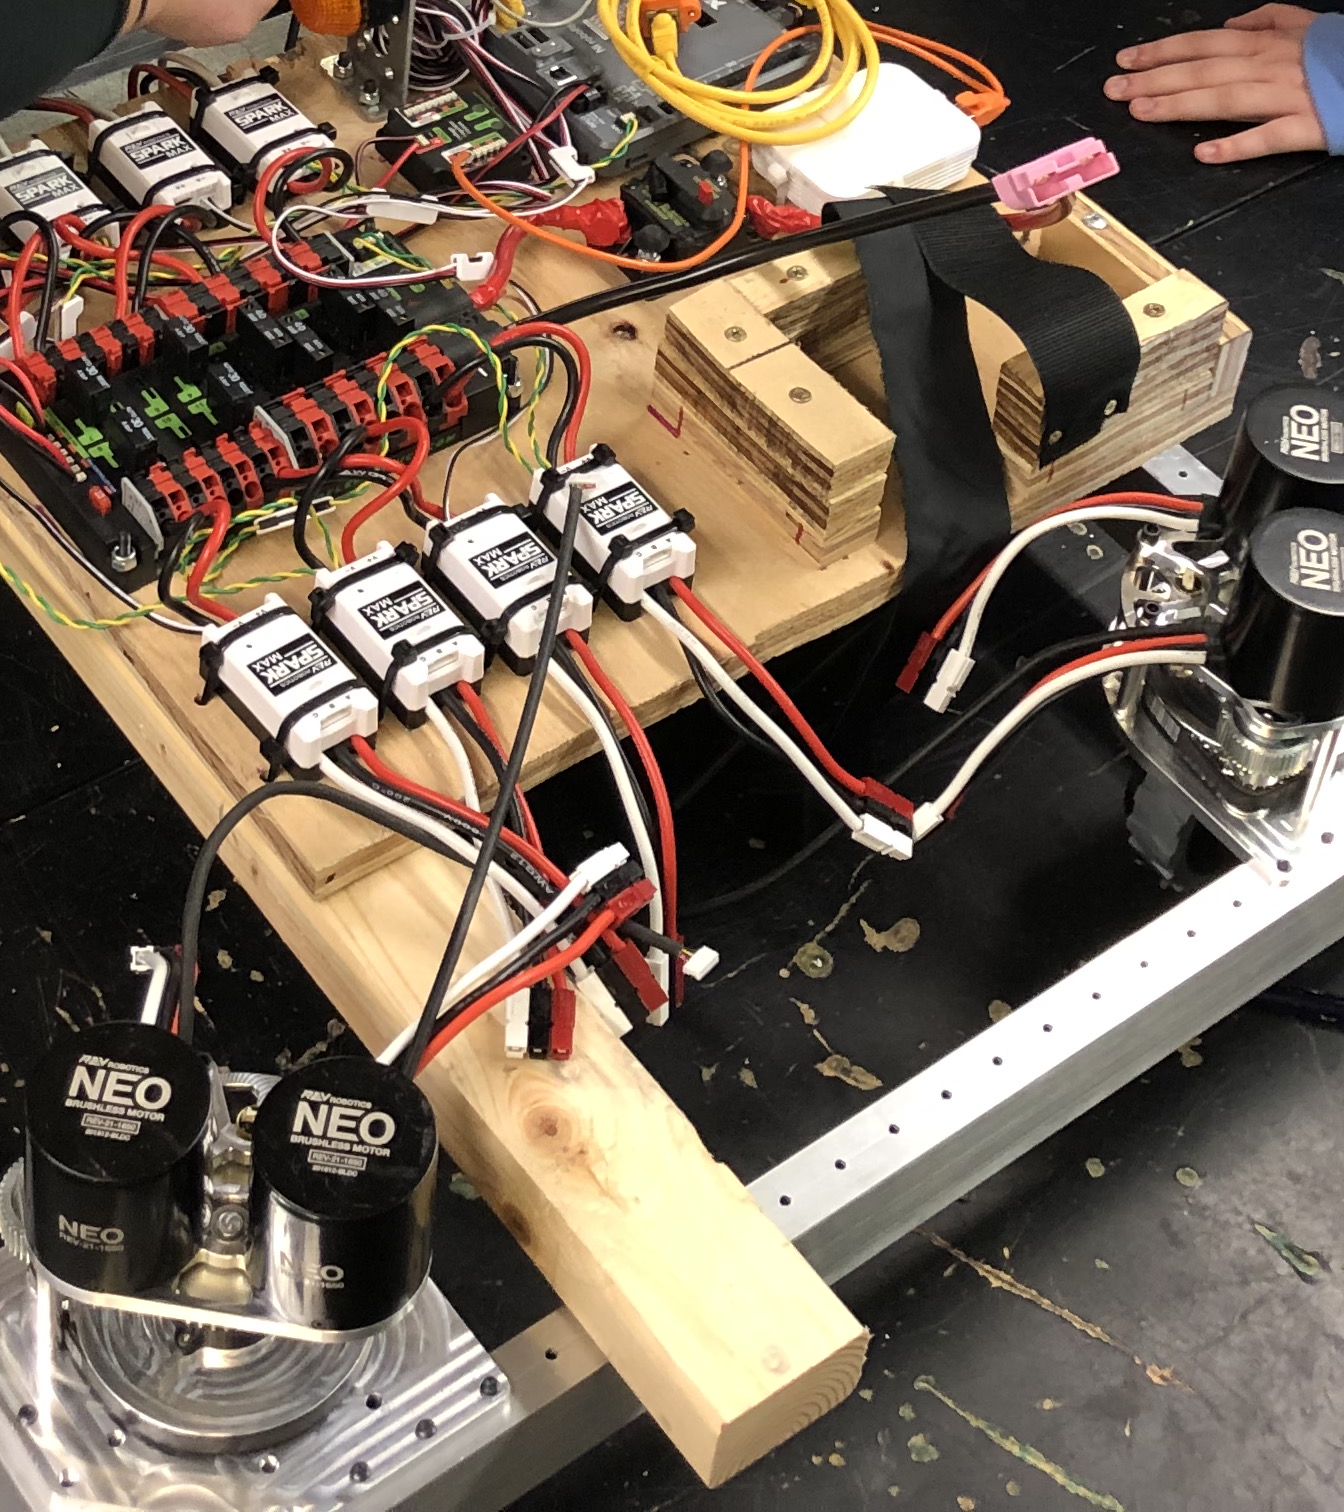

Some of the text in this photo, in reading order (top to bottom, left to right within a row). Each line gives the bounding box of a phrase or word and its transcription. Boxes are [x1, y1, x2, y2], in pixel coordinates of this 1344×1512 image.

[234, 99, 290, 127] SPARK
[268, 106, 295, 124] MAX
[129, 135, 187, 162] SPARK
[165, 142, 193, 159] MAX
[14, 173, 74, 205] SPARK
[50, 182, 80, 200] MAX
[1289, 403, 1320, 461] NEO
[581, 496, 608, 513] MAX
[591, 489, 647, 526] SPARK
[471, 547, 501, 567] MAX
[481, 540, 543, 579] SPARK
[1297, 528, 1332, 591] NEO
[361, 596, 393, 617] MAX
[371, 590, 435, 629] SPARK
[251, 651, 282, 673] MAX
[260, 643, 326, 685] SPARK
[68, 1065, 172, 1110] NEO
[64, 1097, 166, 1123] BRUSHLESS MOTOR
[292, 1100, 396, 1146] NEO
[289, 1133, 391, 1158] BRUSHLESS MOTOR
[58, 1213, 125, 1245] NEO
